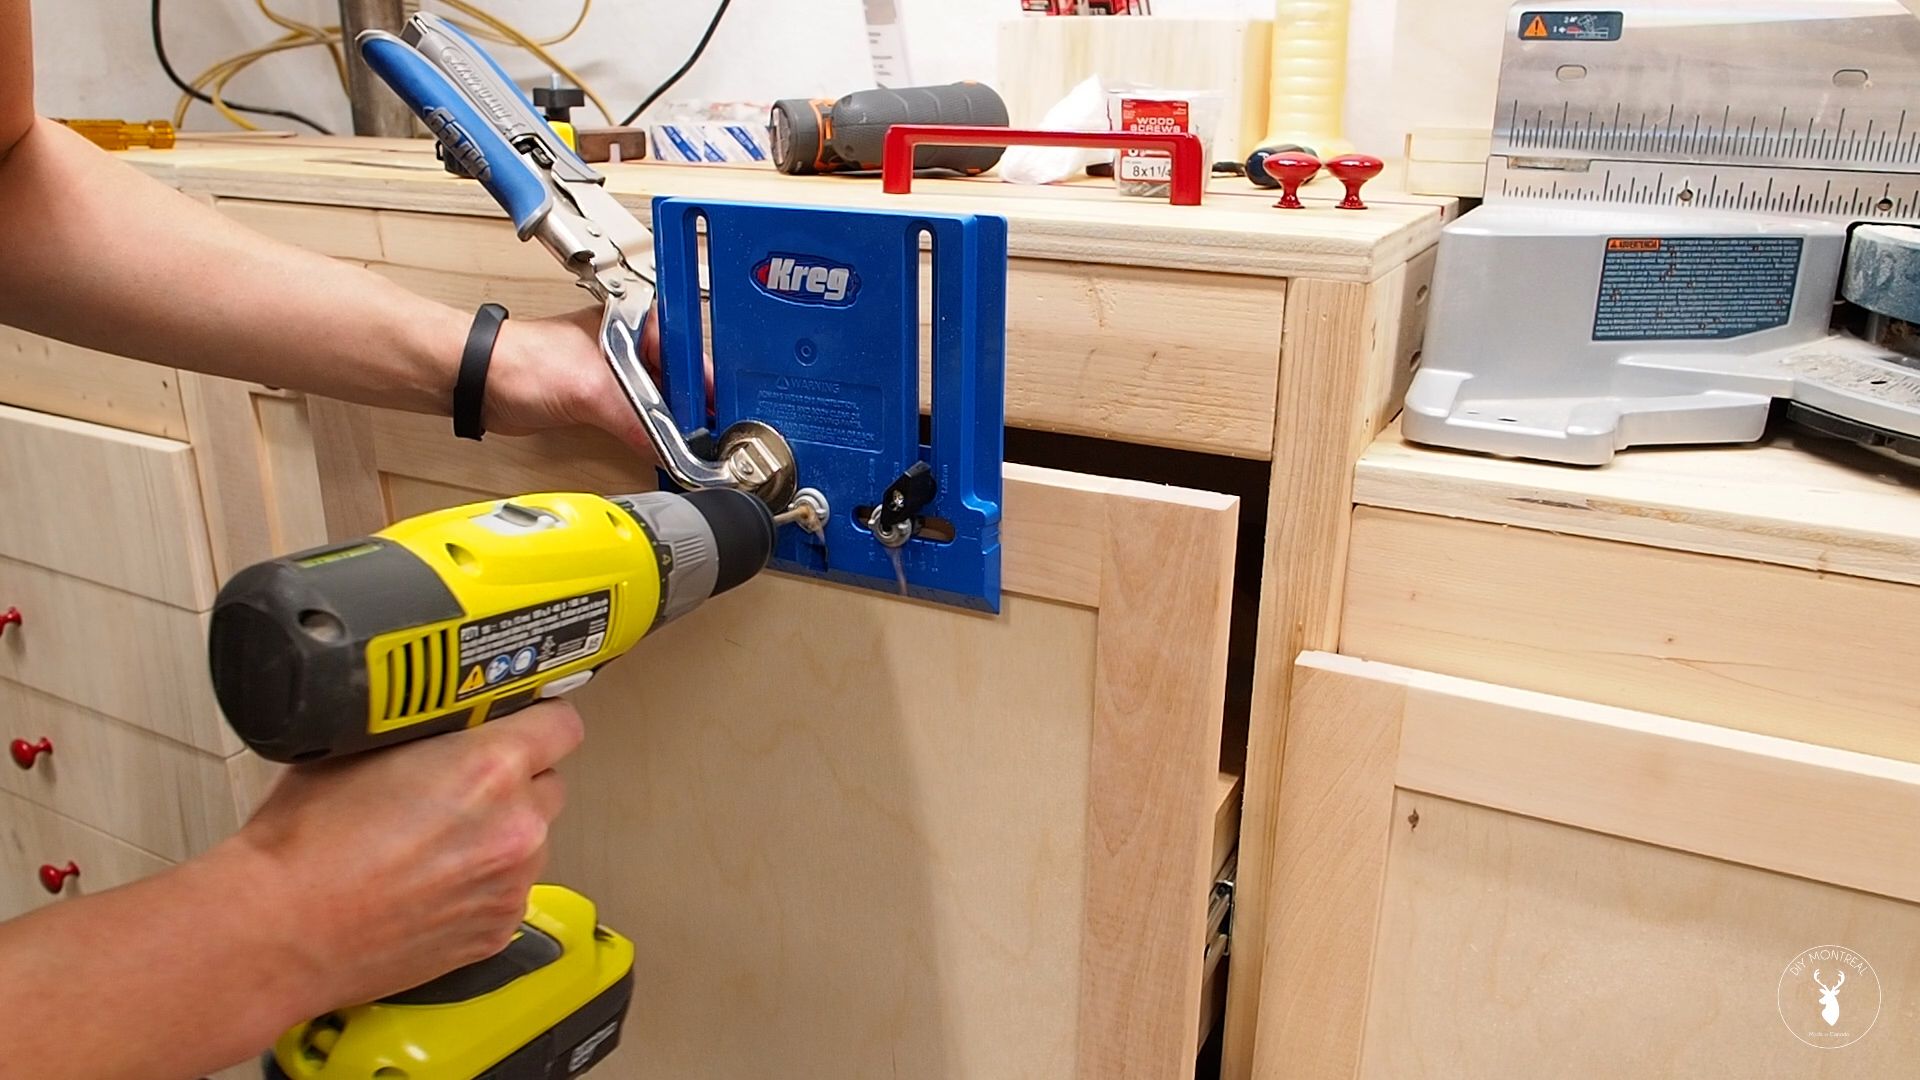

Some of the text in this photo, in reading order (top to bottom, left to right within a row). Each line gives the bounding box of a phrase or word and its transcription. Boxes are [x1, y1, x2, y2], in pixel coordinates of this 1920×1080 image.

[1136, 117, 1175, 125] WOOD
[1130, 124, 1181, 133] SCREWS
[767, 258, 850, 301] Kreg
[789, 377, 840, 394] WARNING
